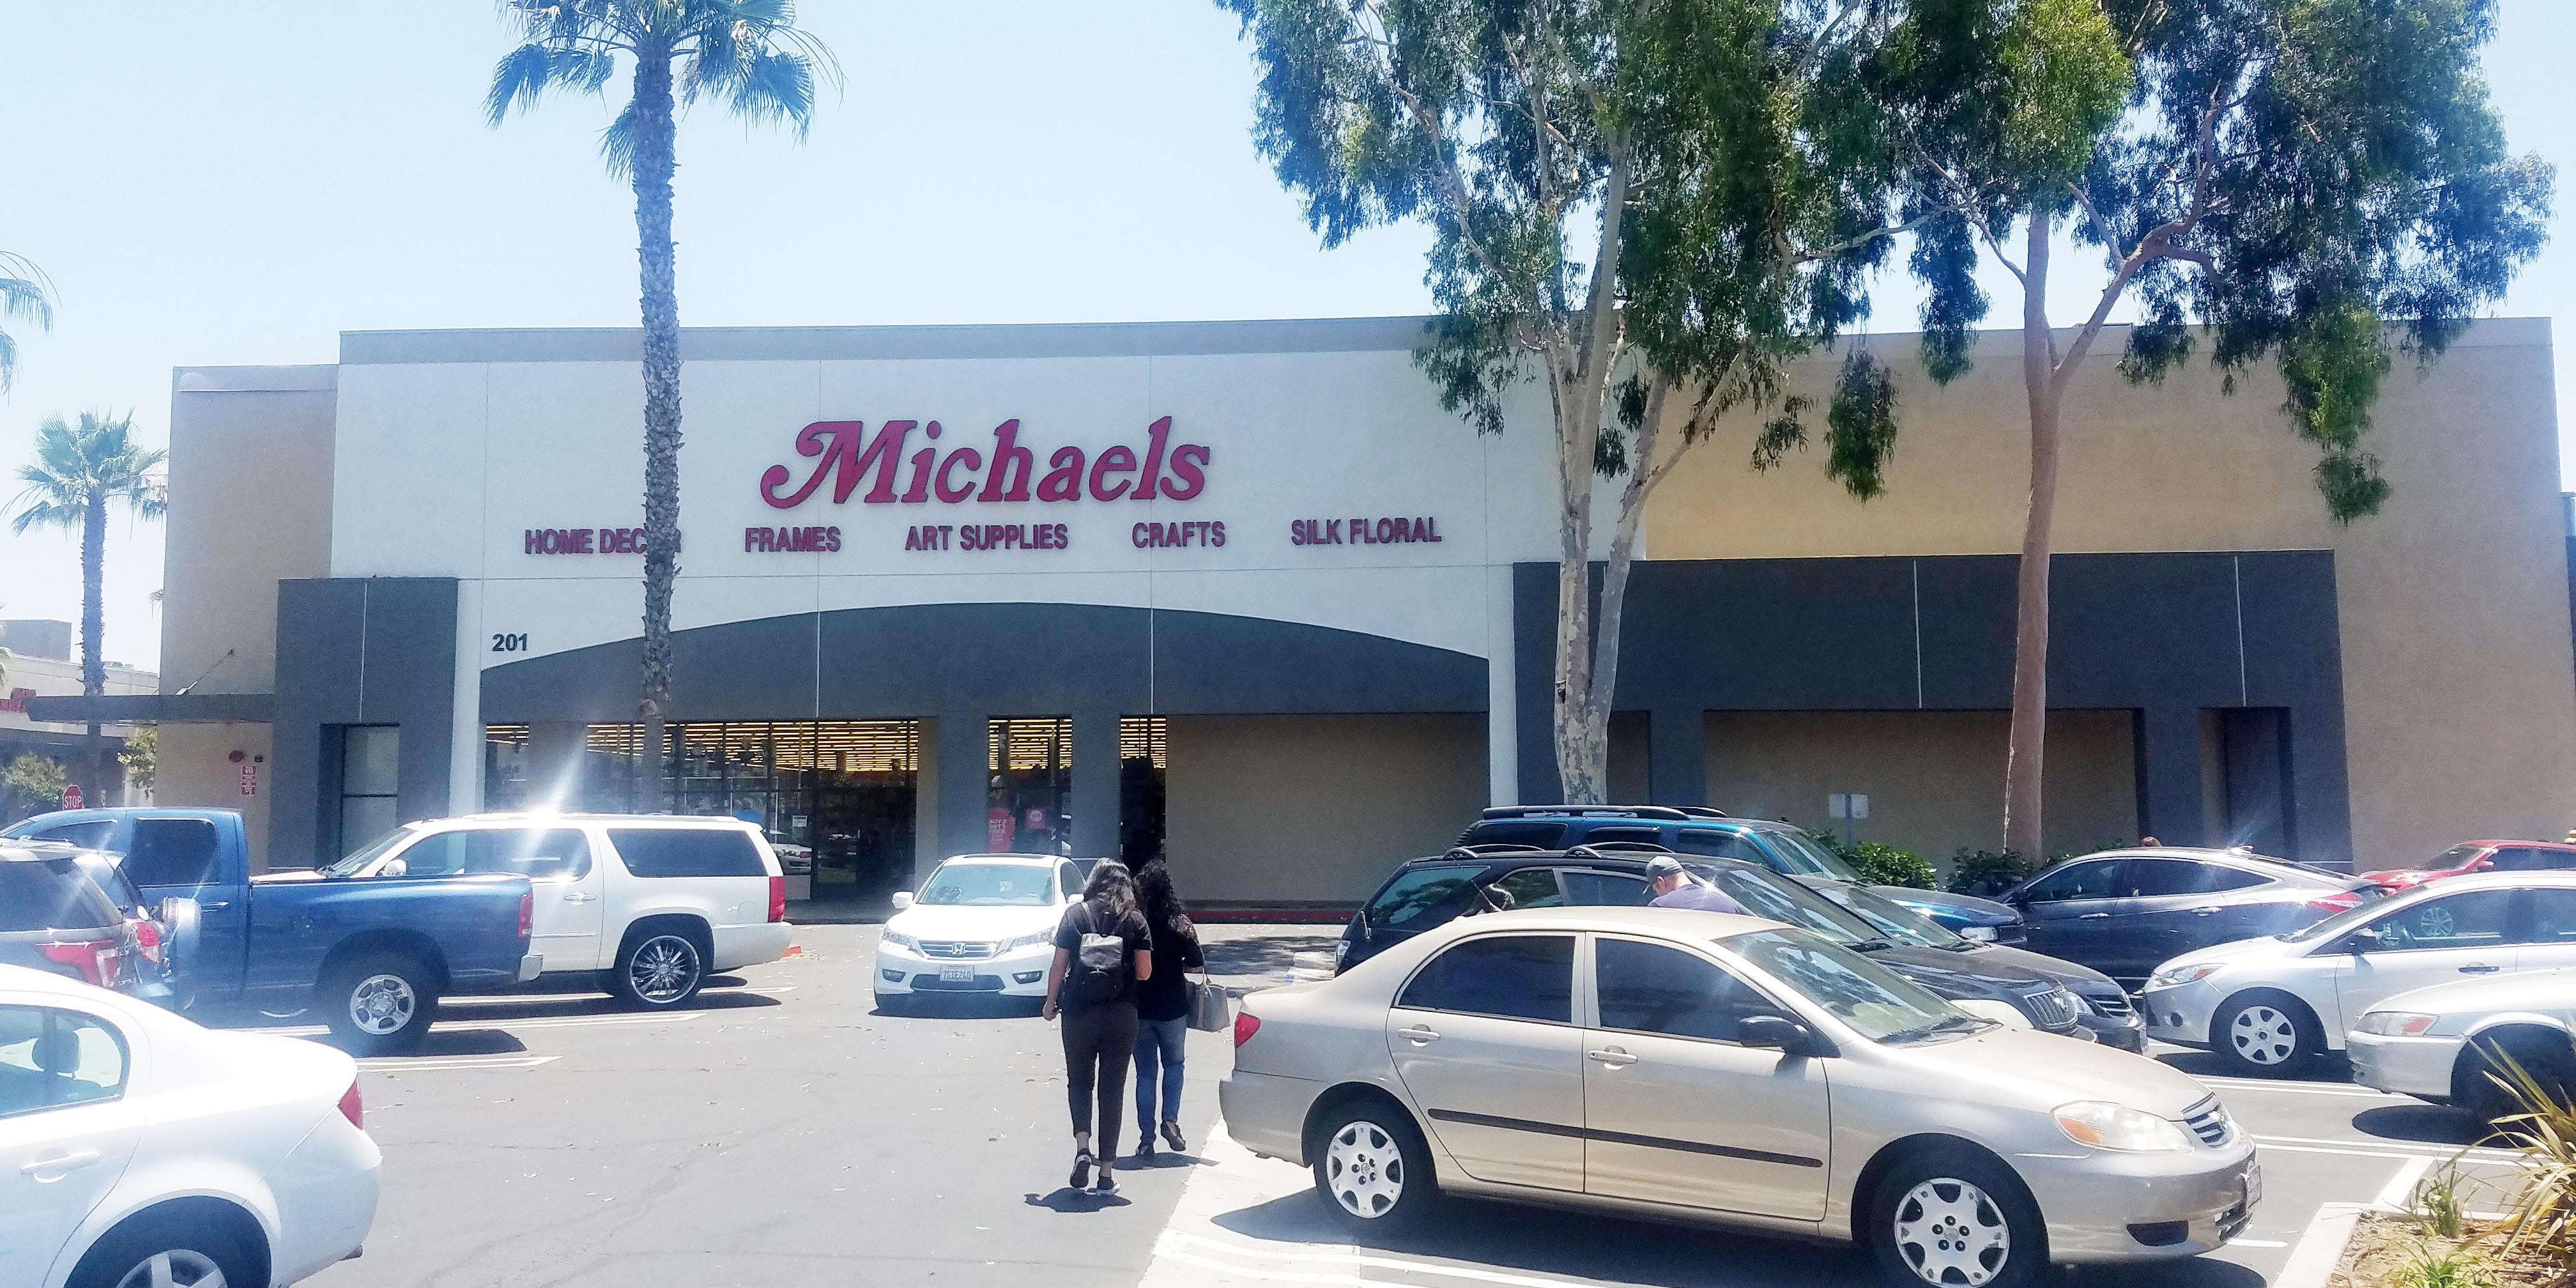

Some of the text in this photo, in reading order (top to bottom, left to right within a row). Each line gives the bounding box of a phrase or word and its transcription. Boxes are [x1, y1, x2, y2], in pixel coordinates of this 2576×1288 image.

[760, 416, 1211, 509] Michaels
[525, 528, 682, 555] HOME DEC
[744, 526, 841, 553] FRAMES
[905, 523, 1069, 551] ART SUPPLIES
[1131, 521, 1226, 548] CRAFTS
[1291, 517, 1442, 546] SILK FLORAL
[491, 633, 528, 652] 201
[65, 795, 82, 808] STOP
